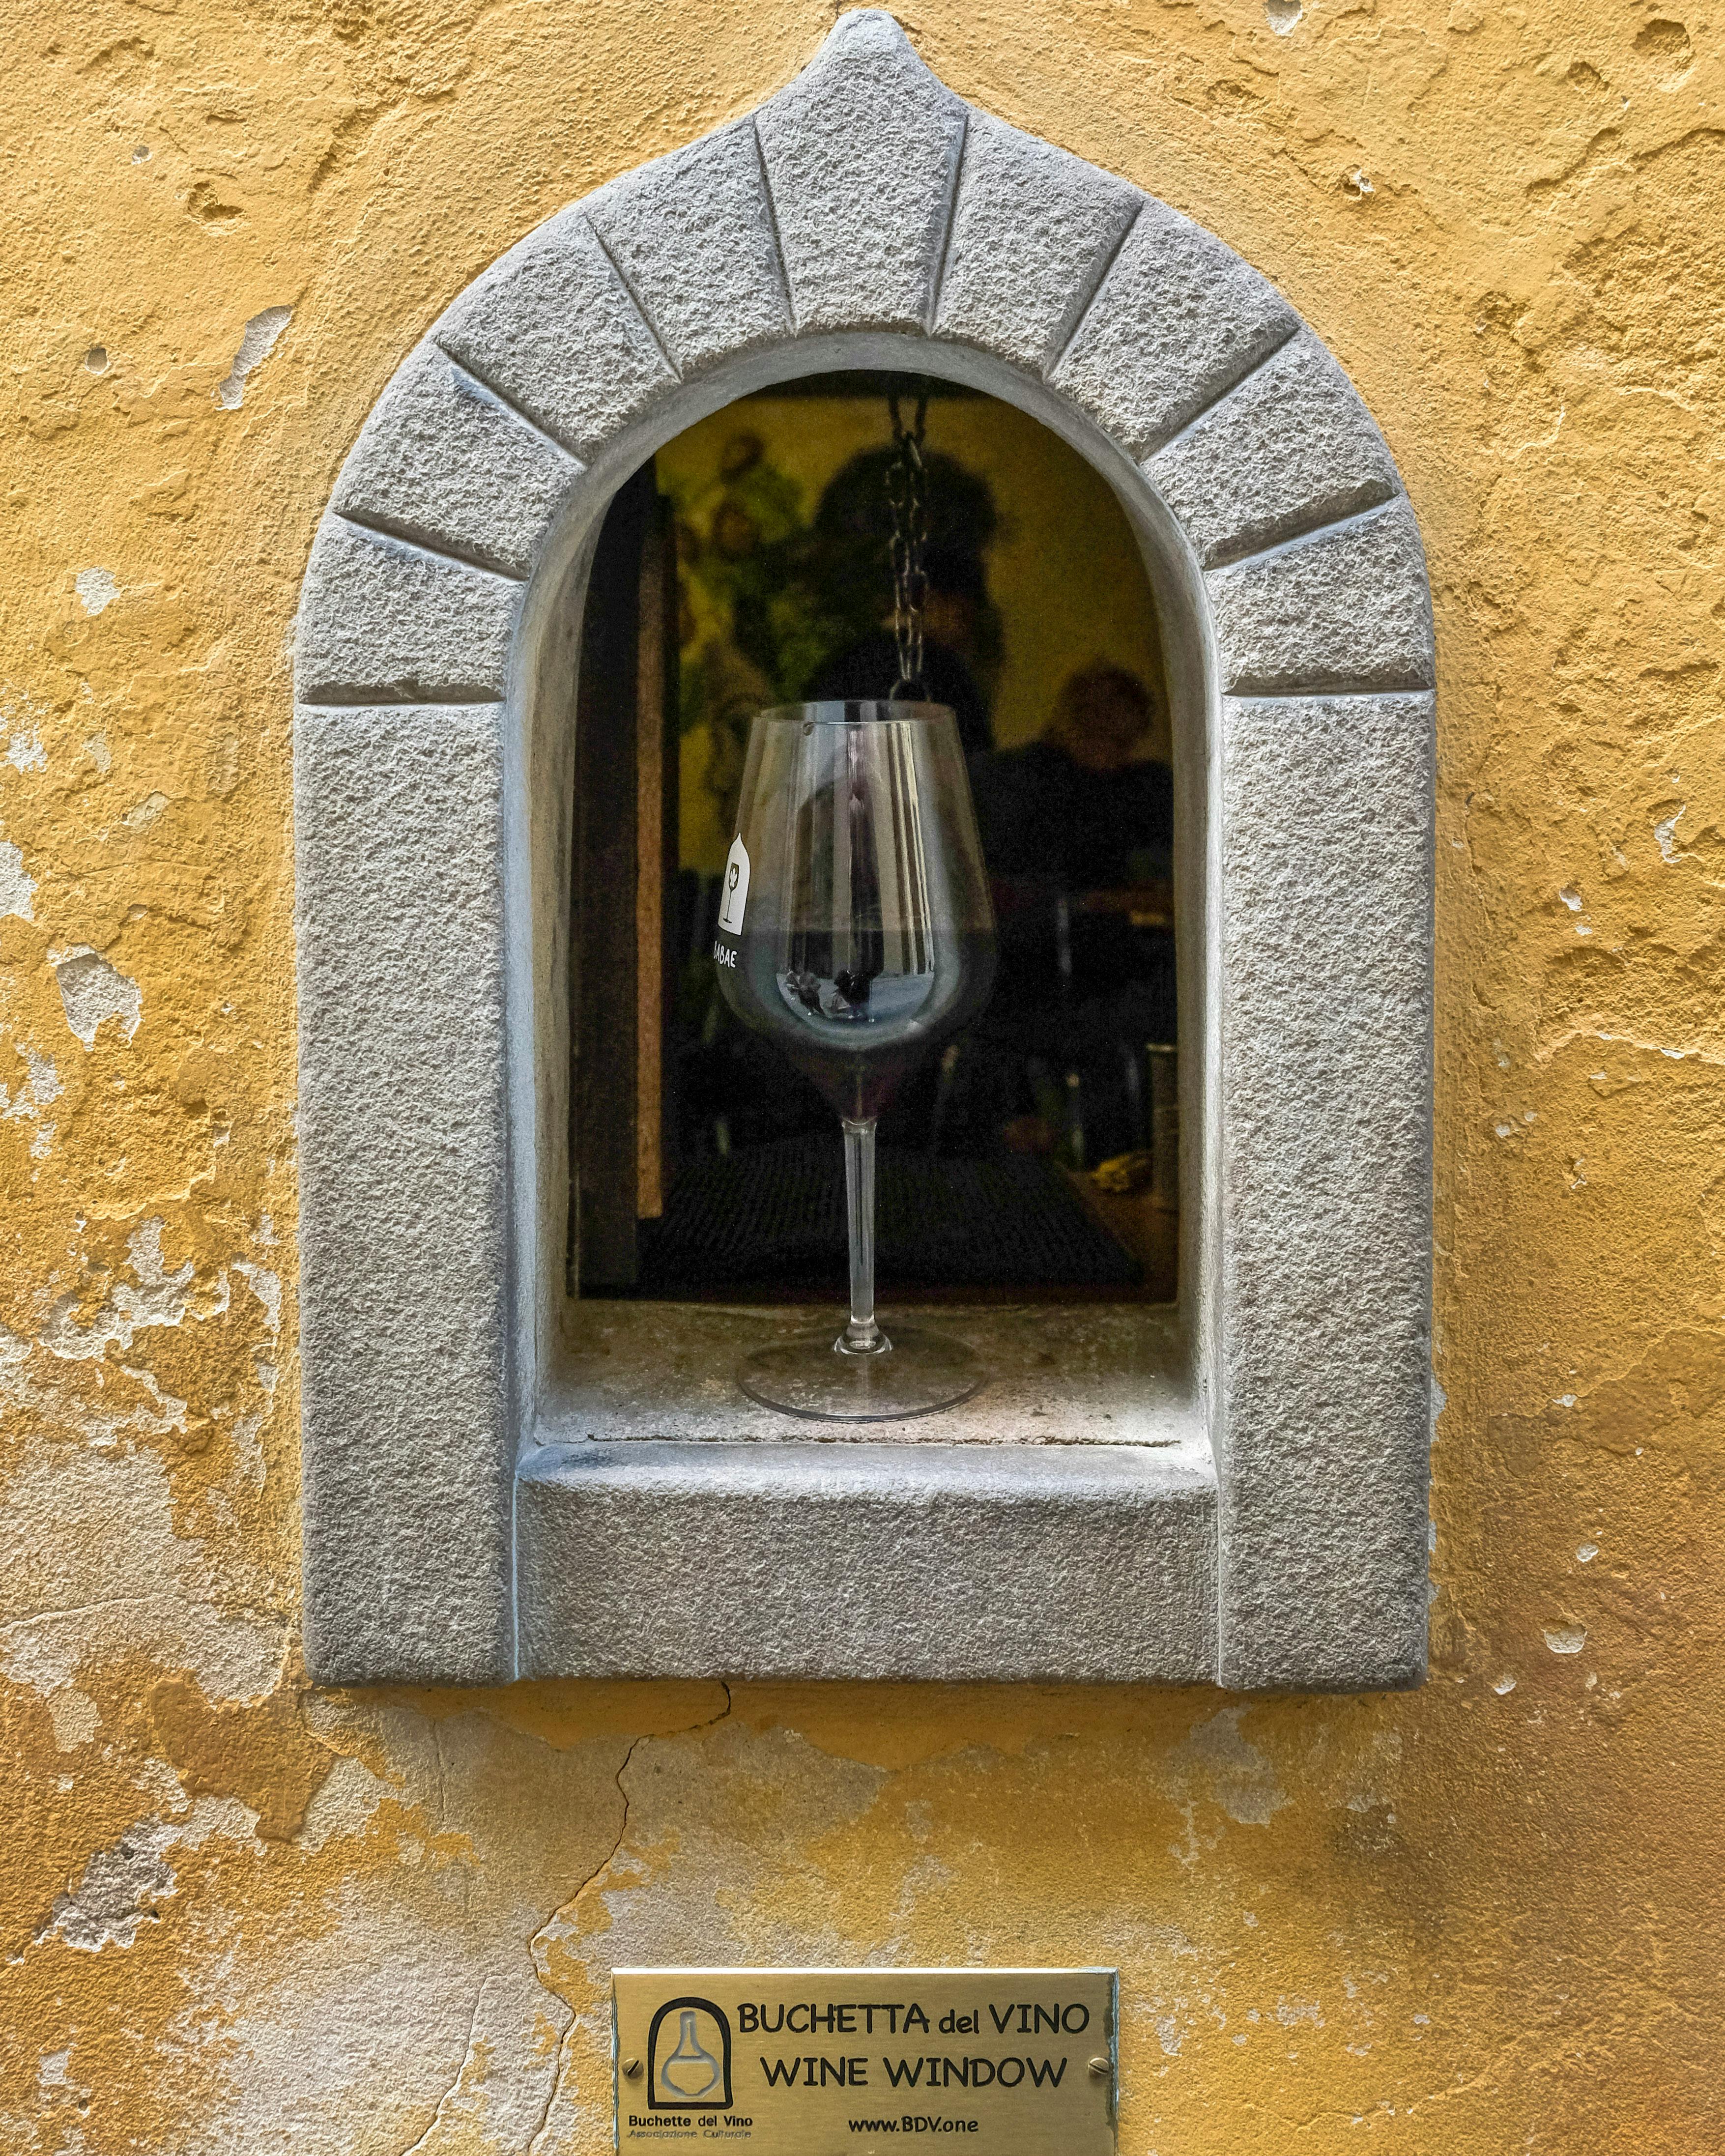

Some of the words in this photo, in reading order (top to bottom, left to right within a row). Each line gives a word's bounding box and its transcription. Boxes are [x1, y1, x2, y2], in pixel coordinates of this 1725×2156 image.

[738, 2003, 930, 2034] BUCHETTA
[938, 2010, 980, 2034] del
[988, 2003, 1090, 2034] VINO
[760, 2057, 869, 2087] WINE
[883, 2057, 1068, 2088] WINDOW
[629, 2115, 691, 2127] Buchette
[698, 2115, 718, 2127] del
[723, 2115, 753, 2127] Vino
[848, 2116, 979, 2133] www.BDV.one
[628, 2129, 697, 2138] Associazione
[703, 2129, 752, 2138] Culturale
